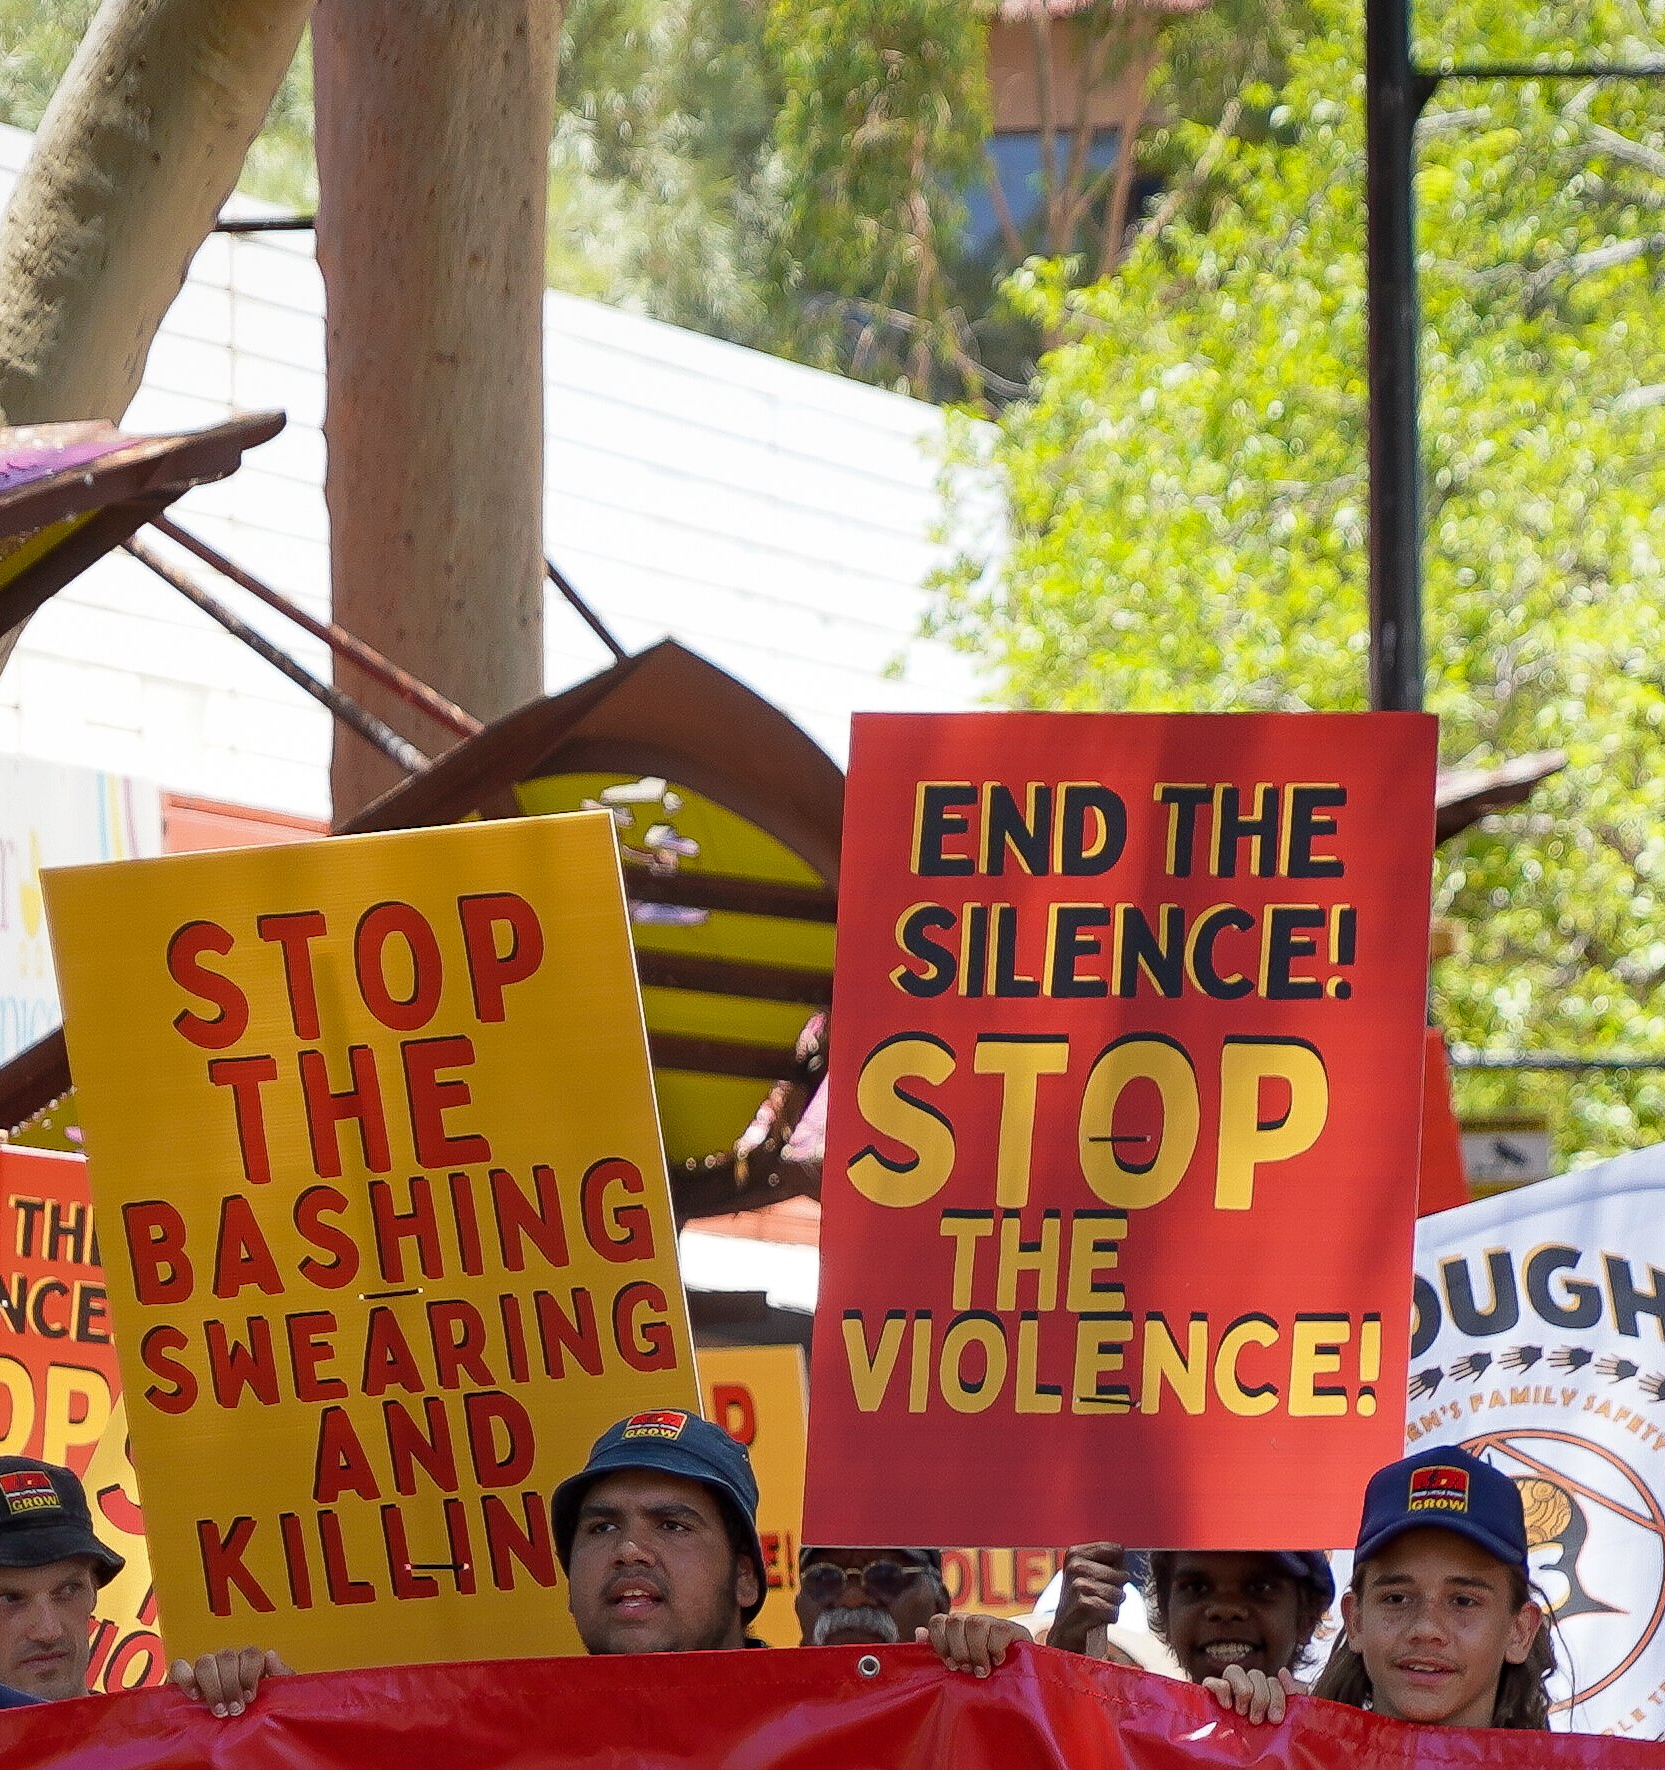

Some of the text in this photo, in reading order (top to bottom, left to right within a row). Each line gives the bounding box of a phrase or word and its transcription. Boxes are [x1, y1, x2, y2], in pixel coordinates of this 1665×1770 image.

[909, 780, 1347, 879] END THE
[167, 891, 545, 1049] STOP
[888, 901, 1357, 1000] SILENCE!
[208, 1034, 492, 1185] THE
[846, 1031, 1329, 1210] STOP
[120, 1156, 655, 1305] BASHING
[939, 1208, 1128, 1313] THE
[140, 1281, 678, 1414] SWEARING
[841, 1309, 1382, 1417] VIOLENCE!
[1470, 1384, 1579, 1413] FAMILY
[313, 1390, 536, 1504] AND
[624, 1427, 677, 1438] GROW
[12, 1495, 58, 1512] GROW
[196, 1491, 560, 1617] KILLIN
[1411, 1498, 1466, 1511] GROW
